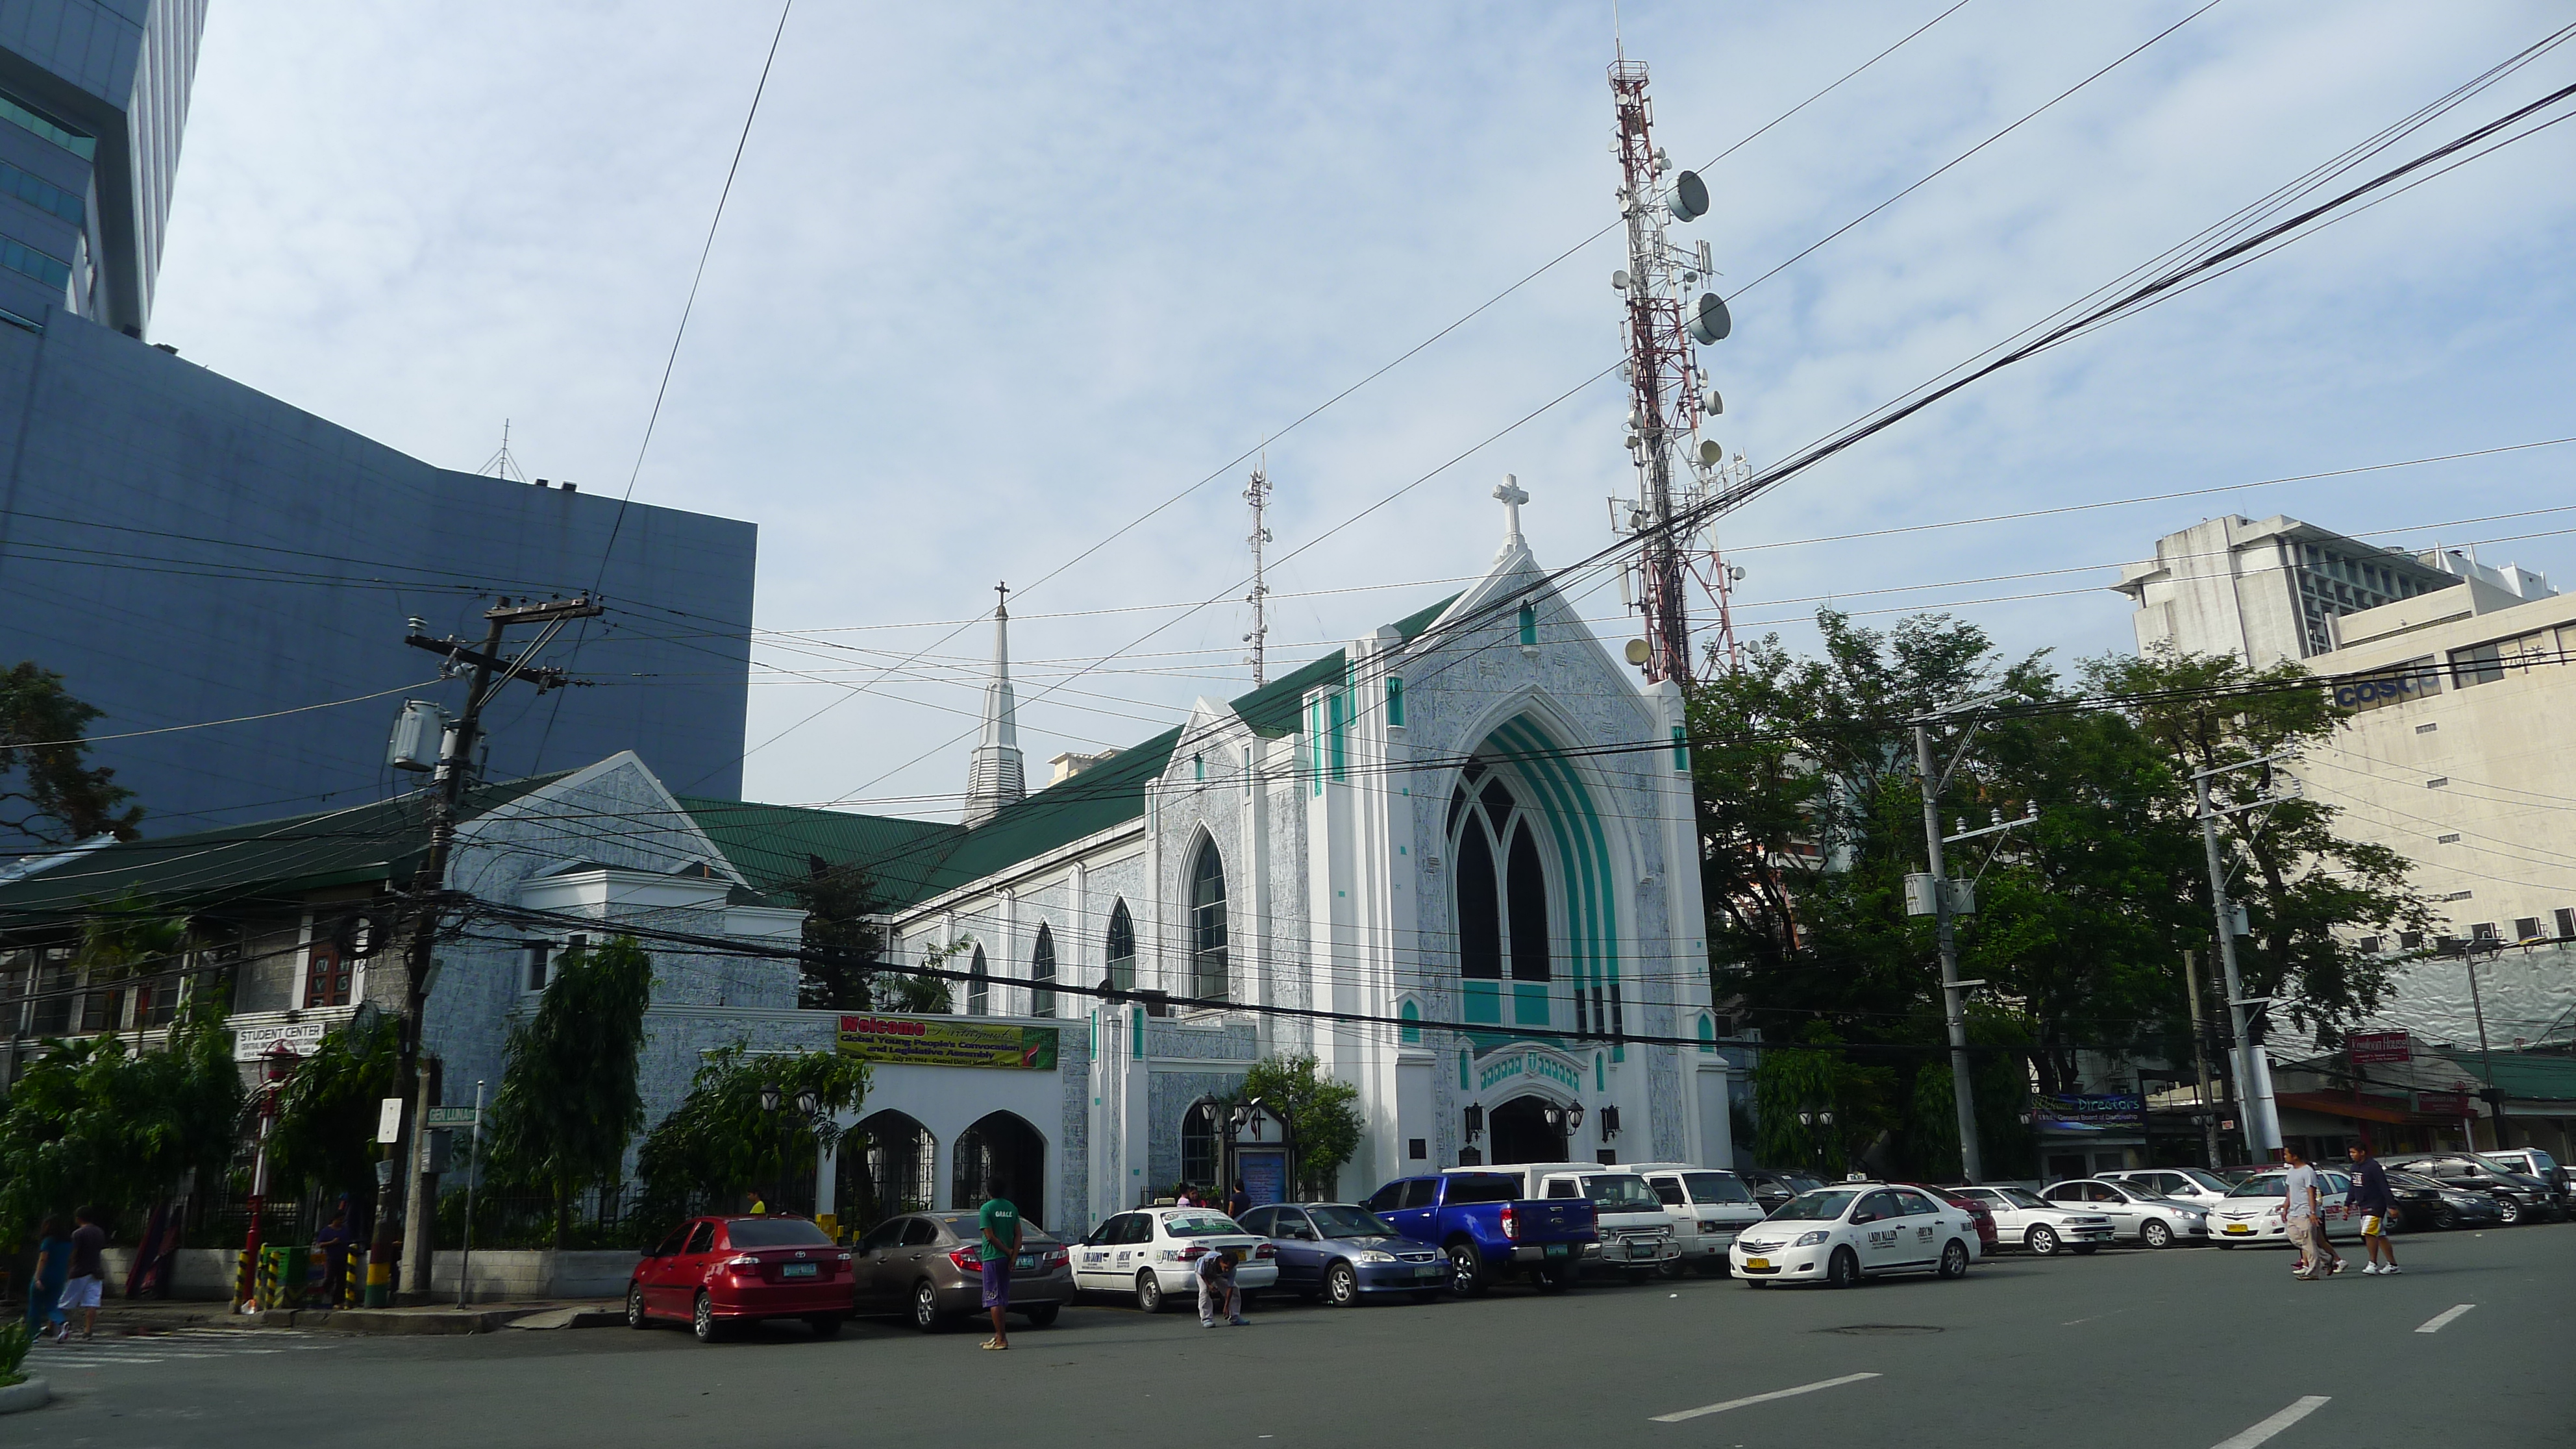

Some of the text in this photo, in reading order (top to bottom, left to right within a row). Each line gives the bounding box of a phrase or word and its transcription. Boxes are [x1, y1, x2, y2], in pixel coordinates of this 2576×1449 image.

[2337, 669, 2439, 707] COSCO
[241, 1025, 320, 1041] STUDENT CENTER
[840, 1015, 926, 1037] Welcome
[840, 1035, 1020, 1051] Global Young People's Convocation
[2351, 1037, 2407, 1051] Kowloon House
[889, 1046, 943, 1055] Legislative
[947, 1051, 995, 1059] Assembly
[2077, 1098, 2140, 1111] Directors
[429, 1108, 445, 1121] GEN
[449, 1108, 469, 1121] LUNA
[1868, 1230, 1898, 1243] LADY ALLEN
